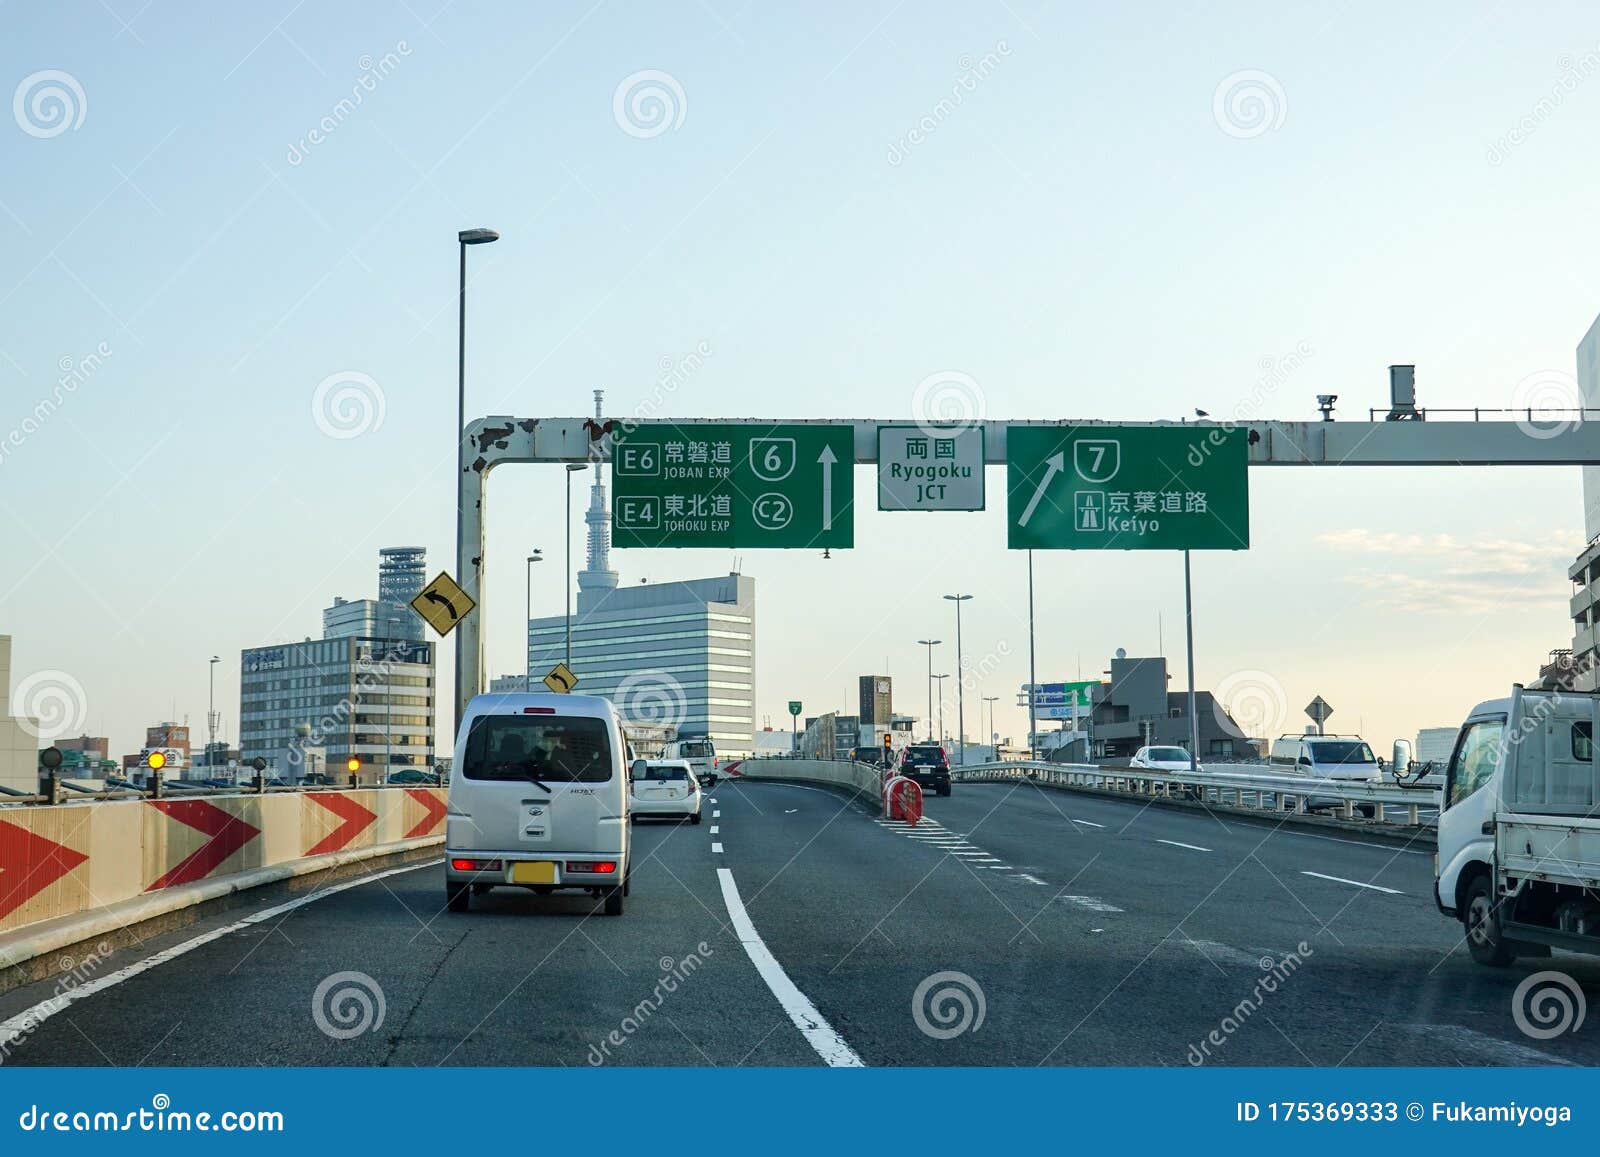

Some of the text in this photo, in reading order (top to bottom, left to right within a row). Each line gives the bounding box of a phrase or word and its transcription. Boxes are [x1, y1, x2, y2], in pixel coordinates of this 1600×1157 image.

[624, 449, 654, 469] E6
[664, 441, 732, 463] 常磐道
[764, 445, 782, 471] 6
[905, 438, 956, 460] 両国
[1088, 446, 1105, 473] 7
[664, 467, 730, 479] JOBAN EXP
[891, 462, 972, 482] Ryogoku
[916, 485, 947, 502] JCT
[1107, 491, 1208, 514] 京葉道路
[624, 503, 653, 522] E4
[664, 494, 732, 517] 東北道
[758, 501, 786, 522] C2
[664, 520, 730, 531] TOHOKU EXP
[1108, 517, 1160, 536] Keiyo
